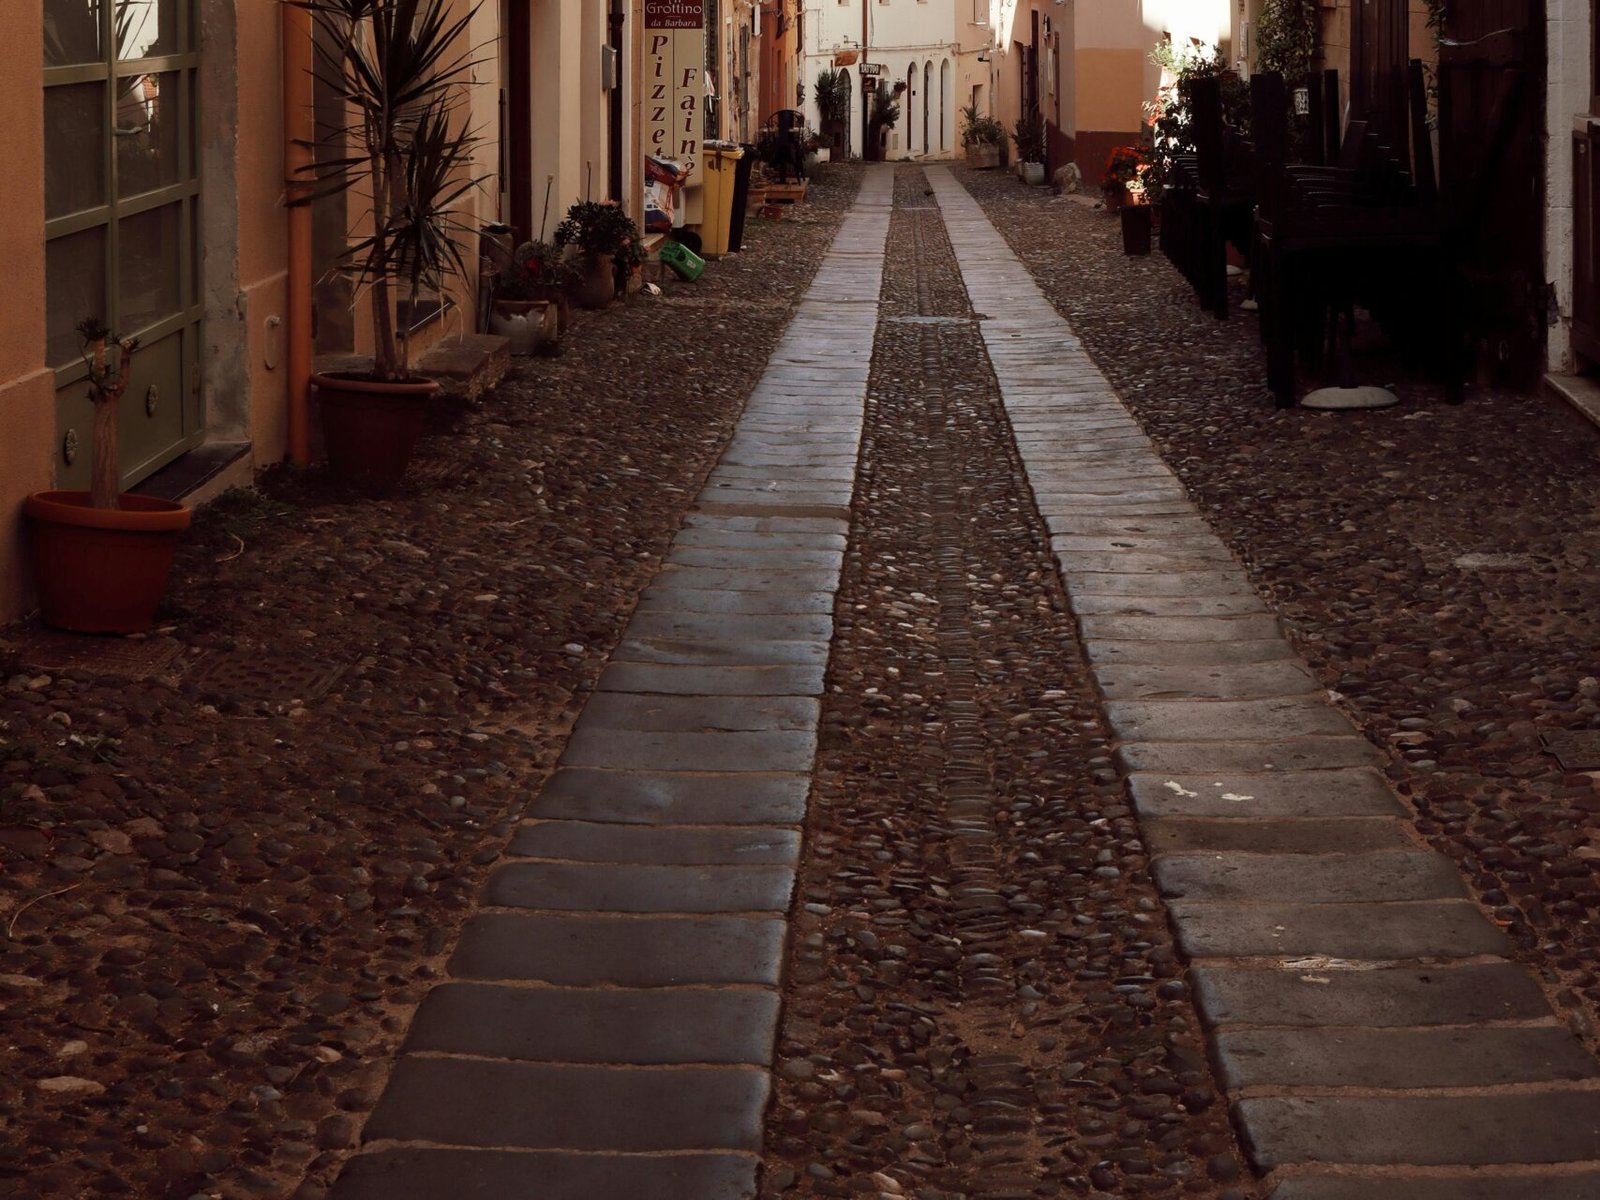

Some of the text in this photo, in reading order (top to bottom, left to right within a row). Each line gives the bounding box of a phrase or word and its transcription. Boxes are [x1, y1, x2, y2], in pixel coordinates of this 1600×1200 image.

[646, 2, 702, 14] Grottino
[651, 18, 697, 27] da Barbara
